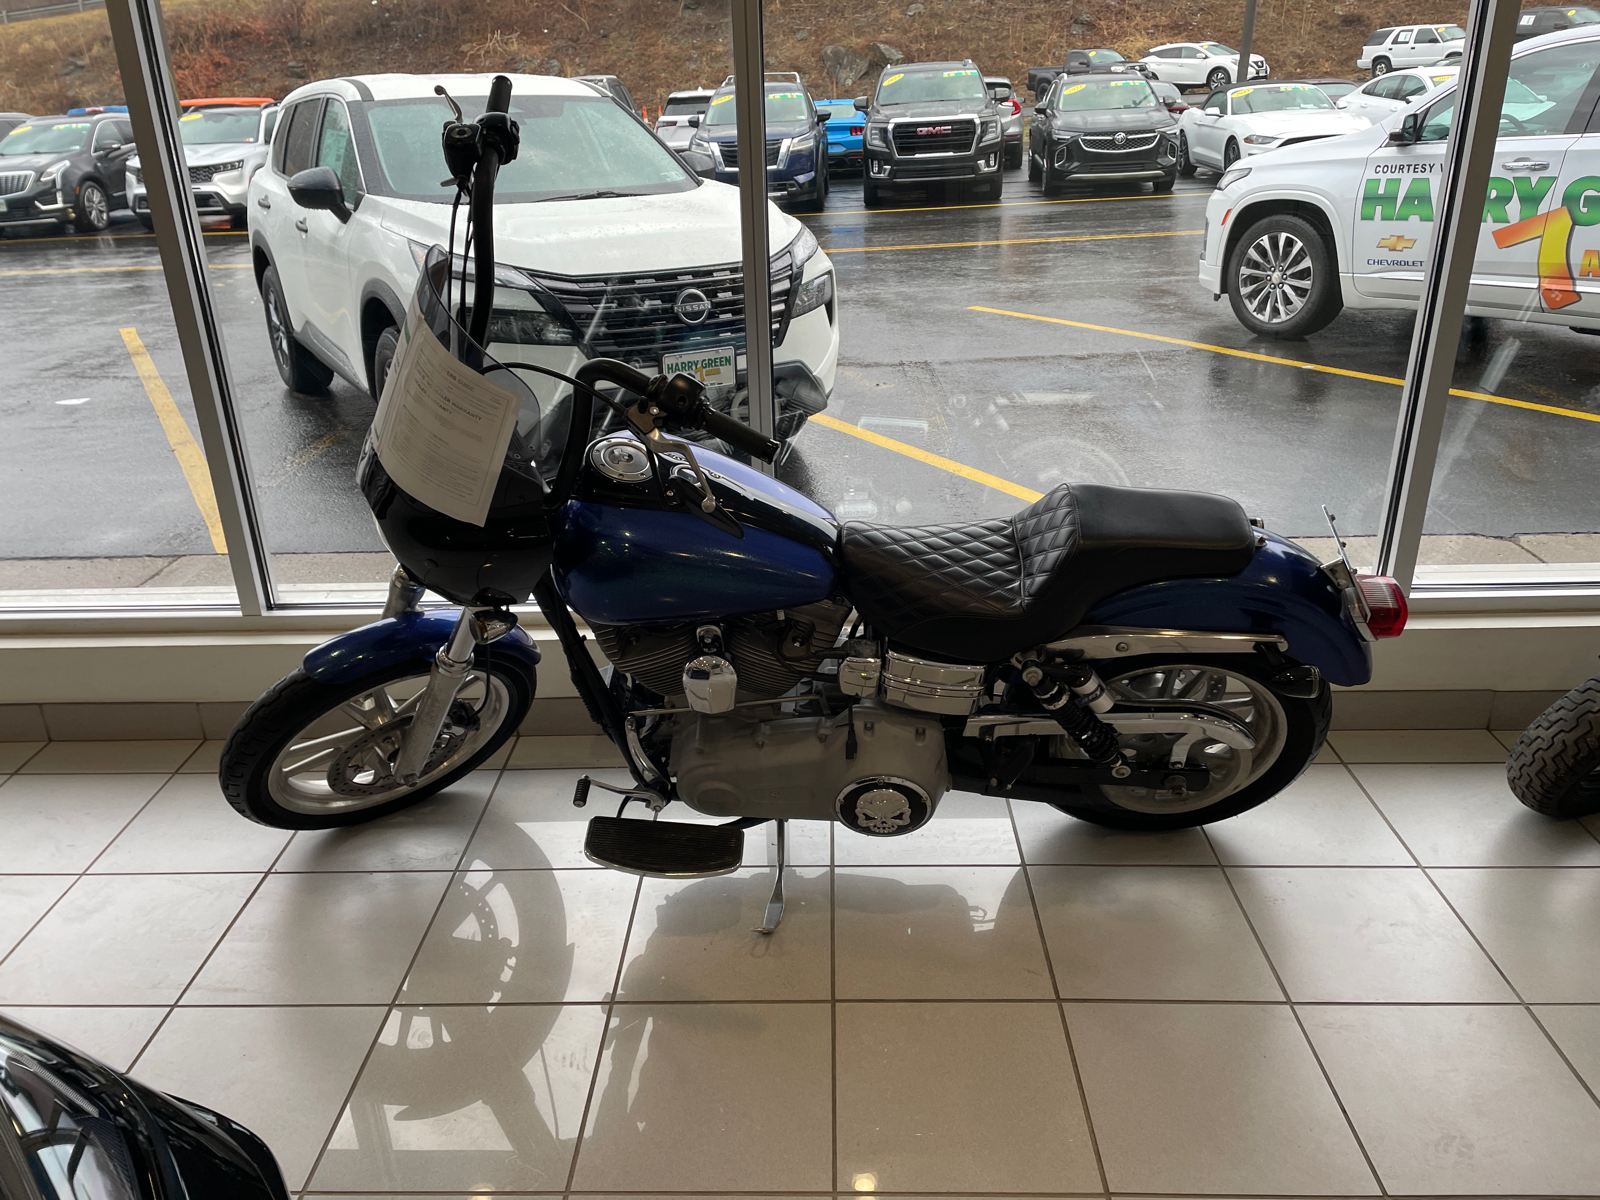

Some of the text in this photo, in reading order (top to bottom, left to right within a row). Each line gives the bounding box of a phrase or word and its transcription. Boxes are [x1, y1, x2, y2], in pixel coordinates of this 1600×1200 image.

[916, 126, 952, 135] GMC
[1374, 163, 1436, 174] COURTESY
[1360, 176, 1558, 223] HARY
[1366, 258, 1424, 267] CHEVROLET
[675, 303, 711, 312] NISSAN
[667, 356, 731, 374] HARRY GREEN
